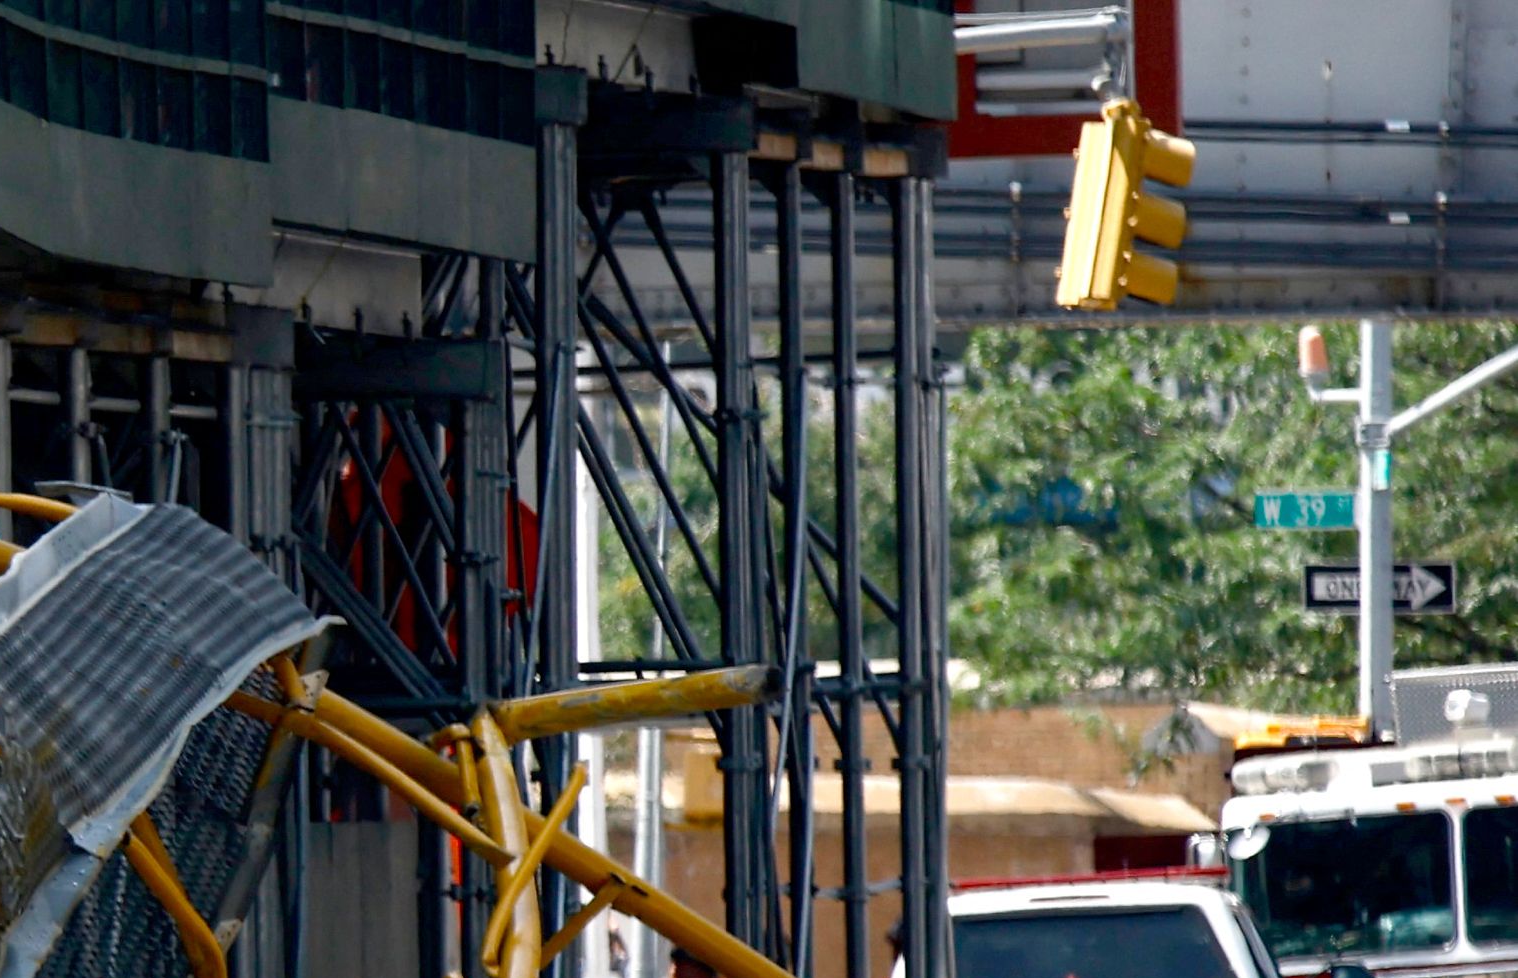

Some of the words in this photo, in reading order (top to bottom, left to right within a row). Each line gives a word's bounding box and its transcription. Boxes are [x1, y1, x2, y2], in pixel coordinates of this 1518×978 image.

[1263, 499, 1281, 526] W
[1296, 499, 1326, 526] 39
[1327, 576, 1360, 600] ON
